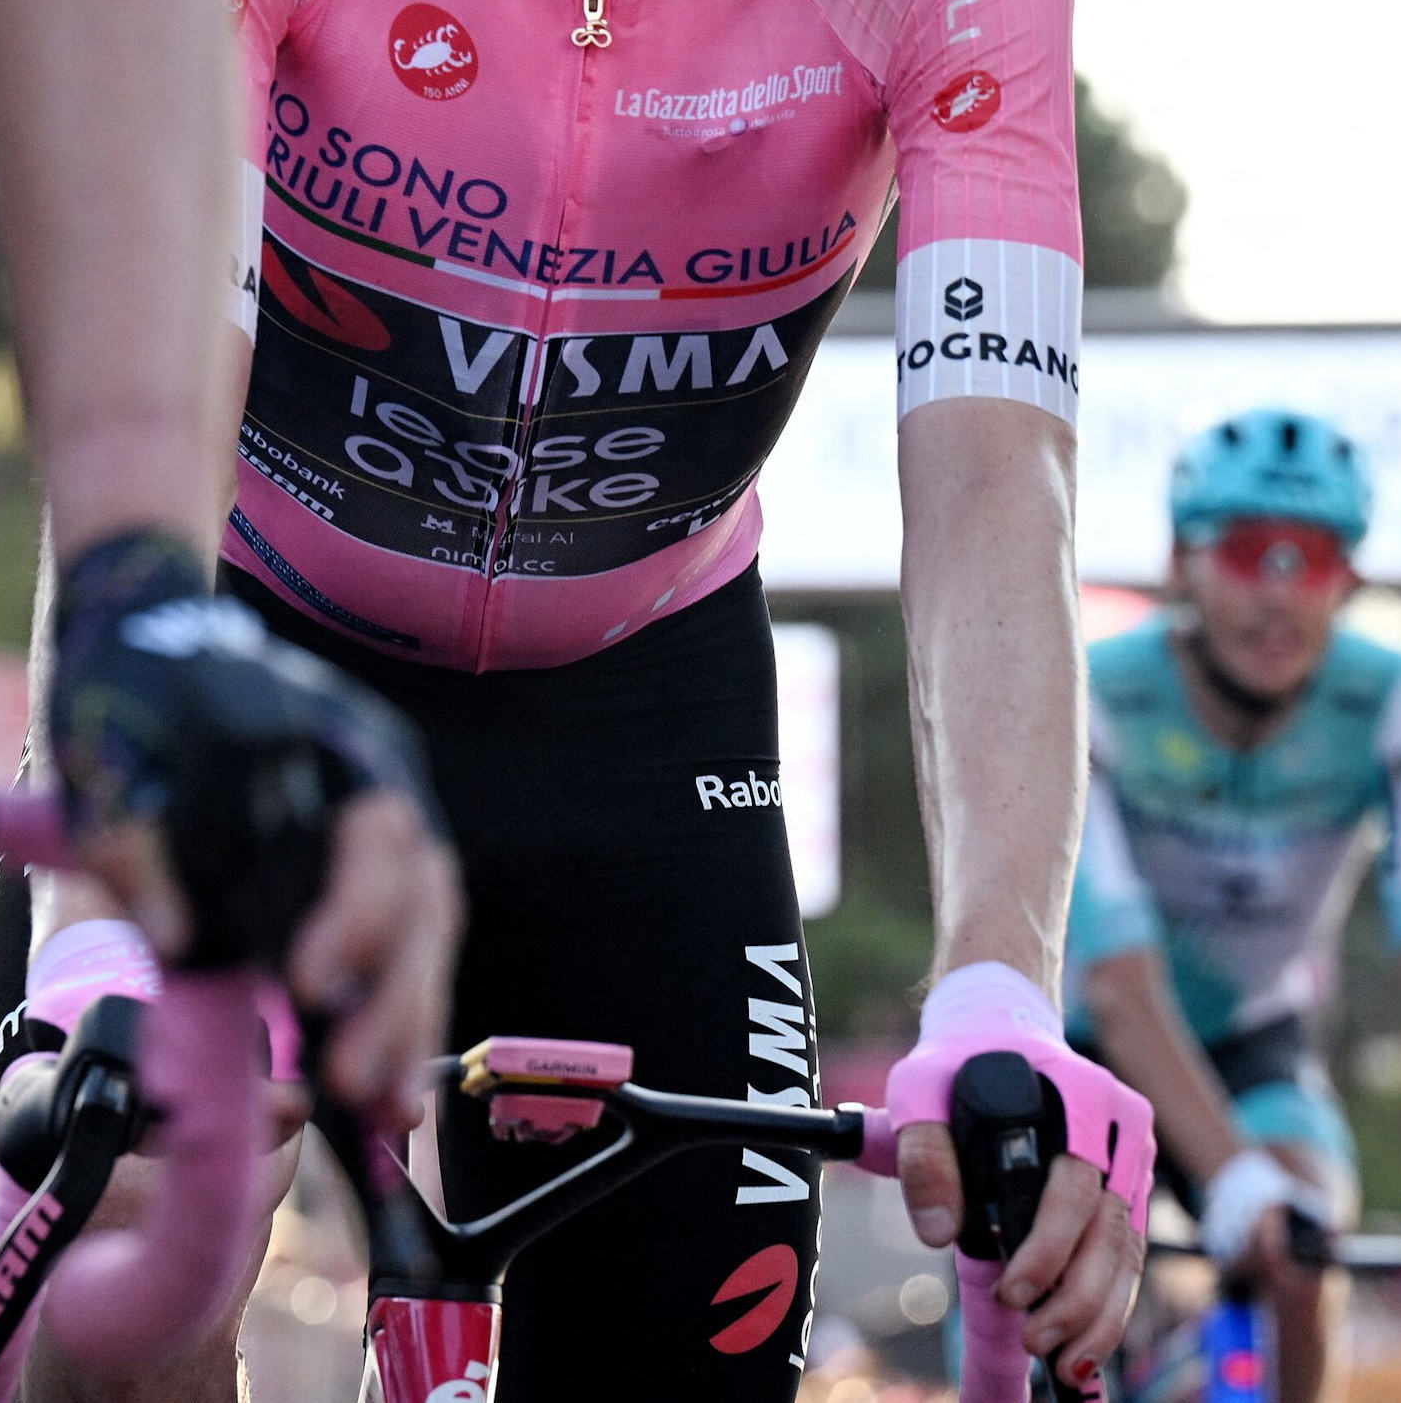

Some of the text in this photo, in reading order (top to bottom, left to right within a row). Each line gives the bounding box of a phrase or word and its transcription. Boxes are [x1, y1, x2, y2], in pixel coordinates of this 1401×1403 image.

[445, 77, 470, 98] ANNI
[614, 61, 843, 121] La Gazzetta dello Sport
[265, 121, 858, 286] RIULI VENEZIA GIULIA
[318, 126, 508, 220] SONO
[437, 314, 789, 406] VISMA
[240, 423, 346, 501] abobank
[734, 941, 812, 1205] VSMA
